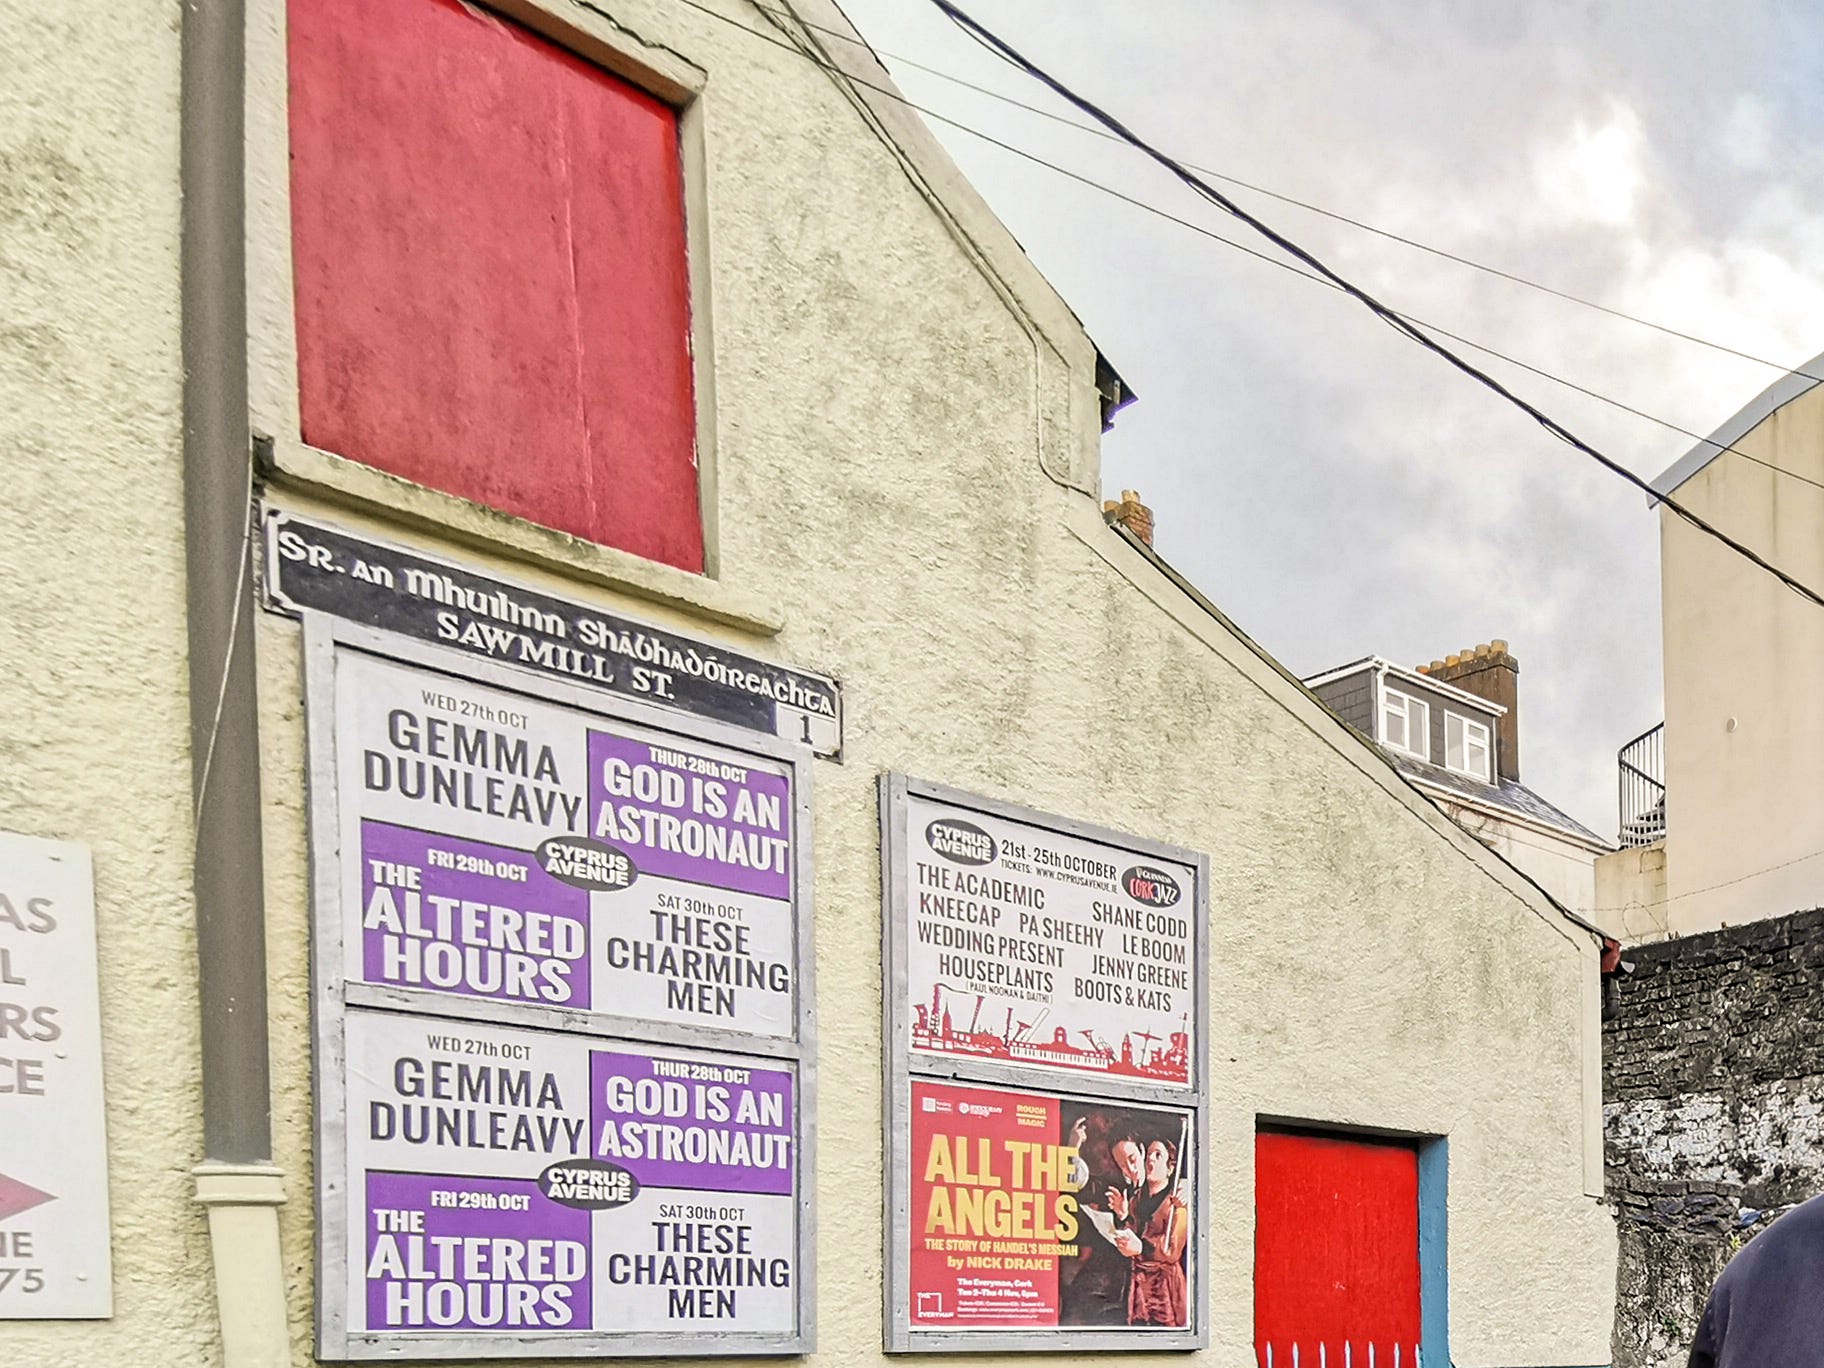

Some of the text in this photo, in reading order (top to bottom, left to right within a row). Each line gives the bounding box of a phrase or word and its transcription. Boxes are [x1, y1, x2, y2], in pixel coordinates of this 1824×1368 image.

[632, 669, 675, 699] ST.
[422, 690, 528, 730] WED 27th OCT
[388, 709, 560, 785] GEMMA
[800, 715, 813, 745] 1
[649, 747, 747, 784] THUR 28th OCT
[364, 749, 582, 832] DUNLEAVY
[604, 757, 780, 831] GOD IS AN
[596, 801, 788, 874] ASTRONAUT
[931, 823, 991, 849] CYPRUS
[931, 838, 991, 862] AVENUE
[368, 859, 422, 890] THE
[428, 848, 528, 882] FRI 29th OCT
[545, 842, 629, 871] CYPRUS
[545, 858, 629, 886] AVENUE
[1001, 839, 1026, 859] 21st
[1033, 847, 1060, 868] 25th
[1064, 855, 1117, 881] OCTOBER
[916, 862, 1045, 910] THE ACADEMIC
[363, 885, 585, 960] ALTERED
[657, 893, 744, 921] SAT 30th OCT
[919, 892, 1104, 948] KNEECAP PA SHEEHY
[1092, 901, 1187, 939] SHANE CODD
[650, 910, 750, 956] THESE
[918, 920, 1064, 968] WEDDING PRESENT
[1123, 933, 1185, 965] LE BOOM
[383, 934, 572, 1002] HOURS
[607, 937, 789, 994] CHARMING
[940, 953, 1053, 993] HOUSEPLANTS
[1092, 954, 1188, 990] JENNY GREENE
[667, 979, 735, 1018] MEN
[1075, 977, 1171, 1012] BOOTS & KATS
[427, 1034, 532, 1061] WED 27th OCT
[394, 1057, 563, 1110] GEMMA
[652, 1060, 750, 1085] THUR 28th OCT
[606, 1075, 783, 1127] GOD IS AN
[370, 1101, 584, 1155] DUNLEAVY
[598, 1120, 790, 1169] ASTRONAUT
[548, 1168, 631, 1187] CYPRUS
[924, 1133, 1079, 1192] ALL THE
[431, 1191, 530, 1211] FRI 29th OCT
[548, 1183, 631, 1201] AVENUE
[373, 1209, 425, 1233] THE
[659, 1204, 744, 1221] SAT 30th OCT
[924, 1186, 1079, 1242] ANGELS
[652, 1222, 752, 1255] THESE
[925, 1238, 944, 1251] THE
[946, 1239, 978, 1252] STORY
[979, 1241, 992, 1253] OF
[1038, 1244, 1079, 1257] MESSIAH
[367, 1234, 586, 1282] ALTERED
[608, 1253, 789, 1288] CHARMING
[947, 1256, 1053, 1271] by NICK DRAKE
[386, 1281, 572, 1326] HOURS
[669, 1289, 736, 1318] MEN
